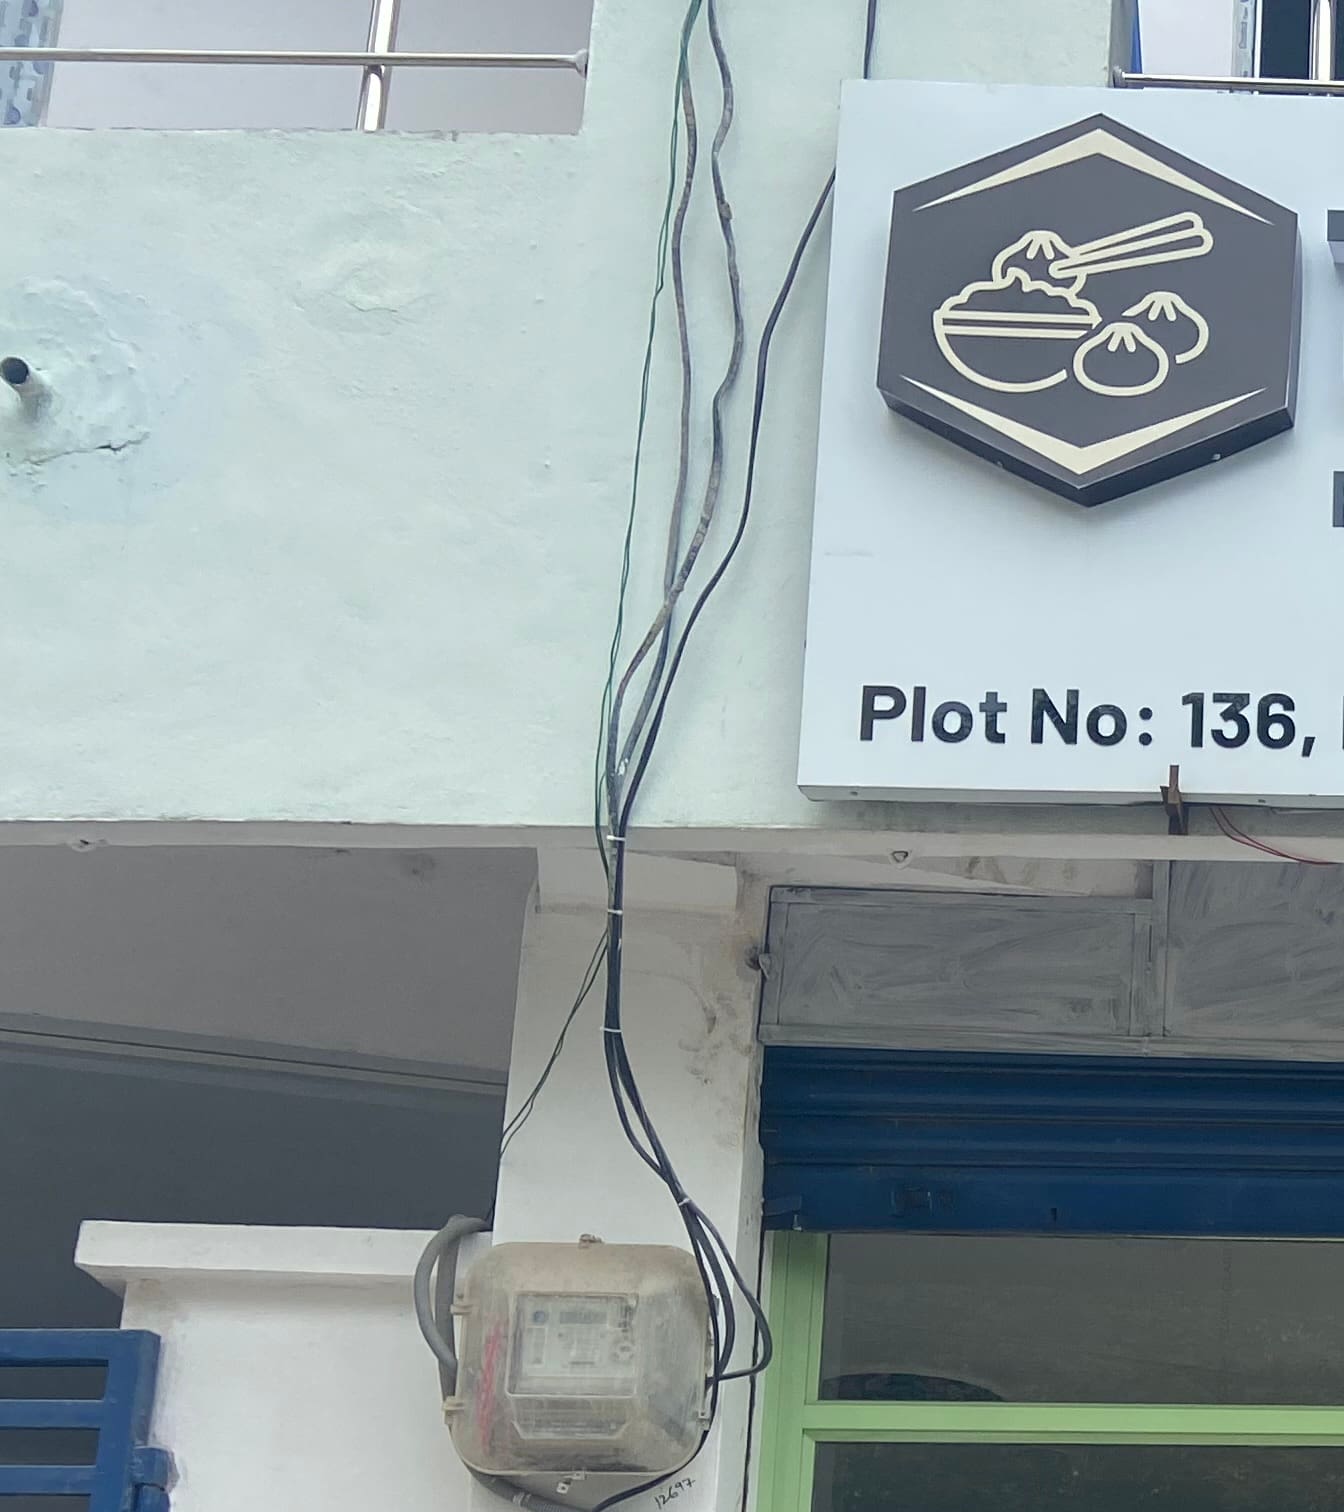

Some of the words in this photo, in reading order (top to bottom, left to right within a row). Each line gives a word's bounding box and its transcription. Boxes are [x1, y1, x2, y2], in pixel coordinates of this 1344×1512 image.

[859, 685, 1008, 746] Plot
[1030, 688, 1153, 748] No:
[1181, 692, 1316, 759] 136,
